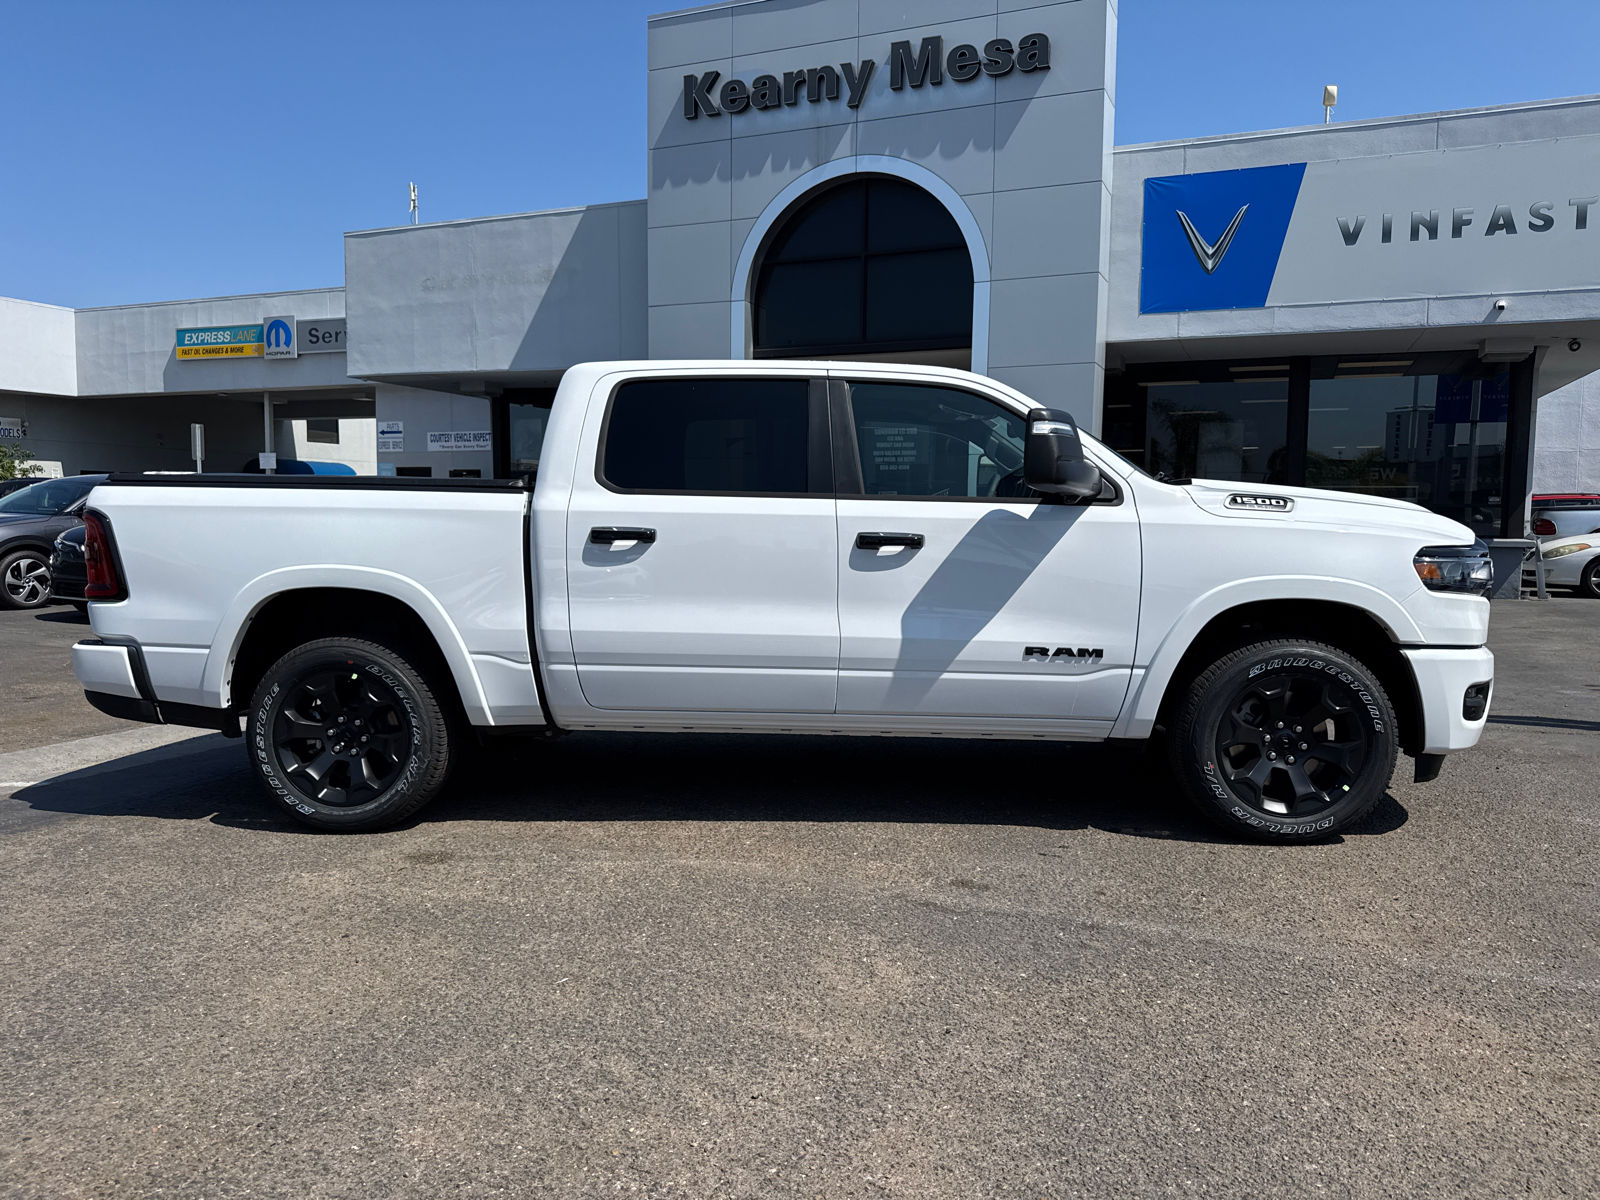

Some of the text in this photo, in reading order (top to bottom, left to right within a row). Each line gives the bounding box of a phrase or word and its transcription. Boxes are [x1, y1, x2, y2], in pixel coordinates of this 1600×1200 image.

[683, 32, 1051, 120] Kearny Mesa
[1336, 195, 1599, 246] VINFAST
[181, 348, 193, 356] FAST
[202, 347, 224, 355] CHANGES
[229, 346, 245, 354] MORE
[386, 422, 400, 431] PARTS
[0, 427, 21, 438] ODELS
[430, 432, 491, 443] COURTESY VEHICLE INSPECT
[1235, 496, 1285, 506] 1500
[1024, 646, 1104, 658] RAM
[1248, 658, 1384, 734] BRIDGESTONE
[256, 682, 316, 815] BRIDGESTONE
